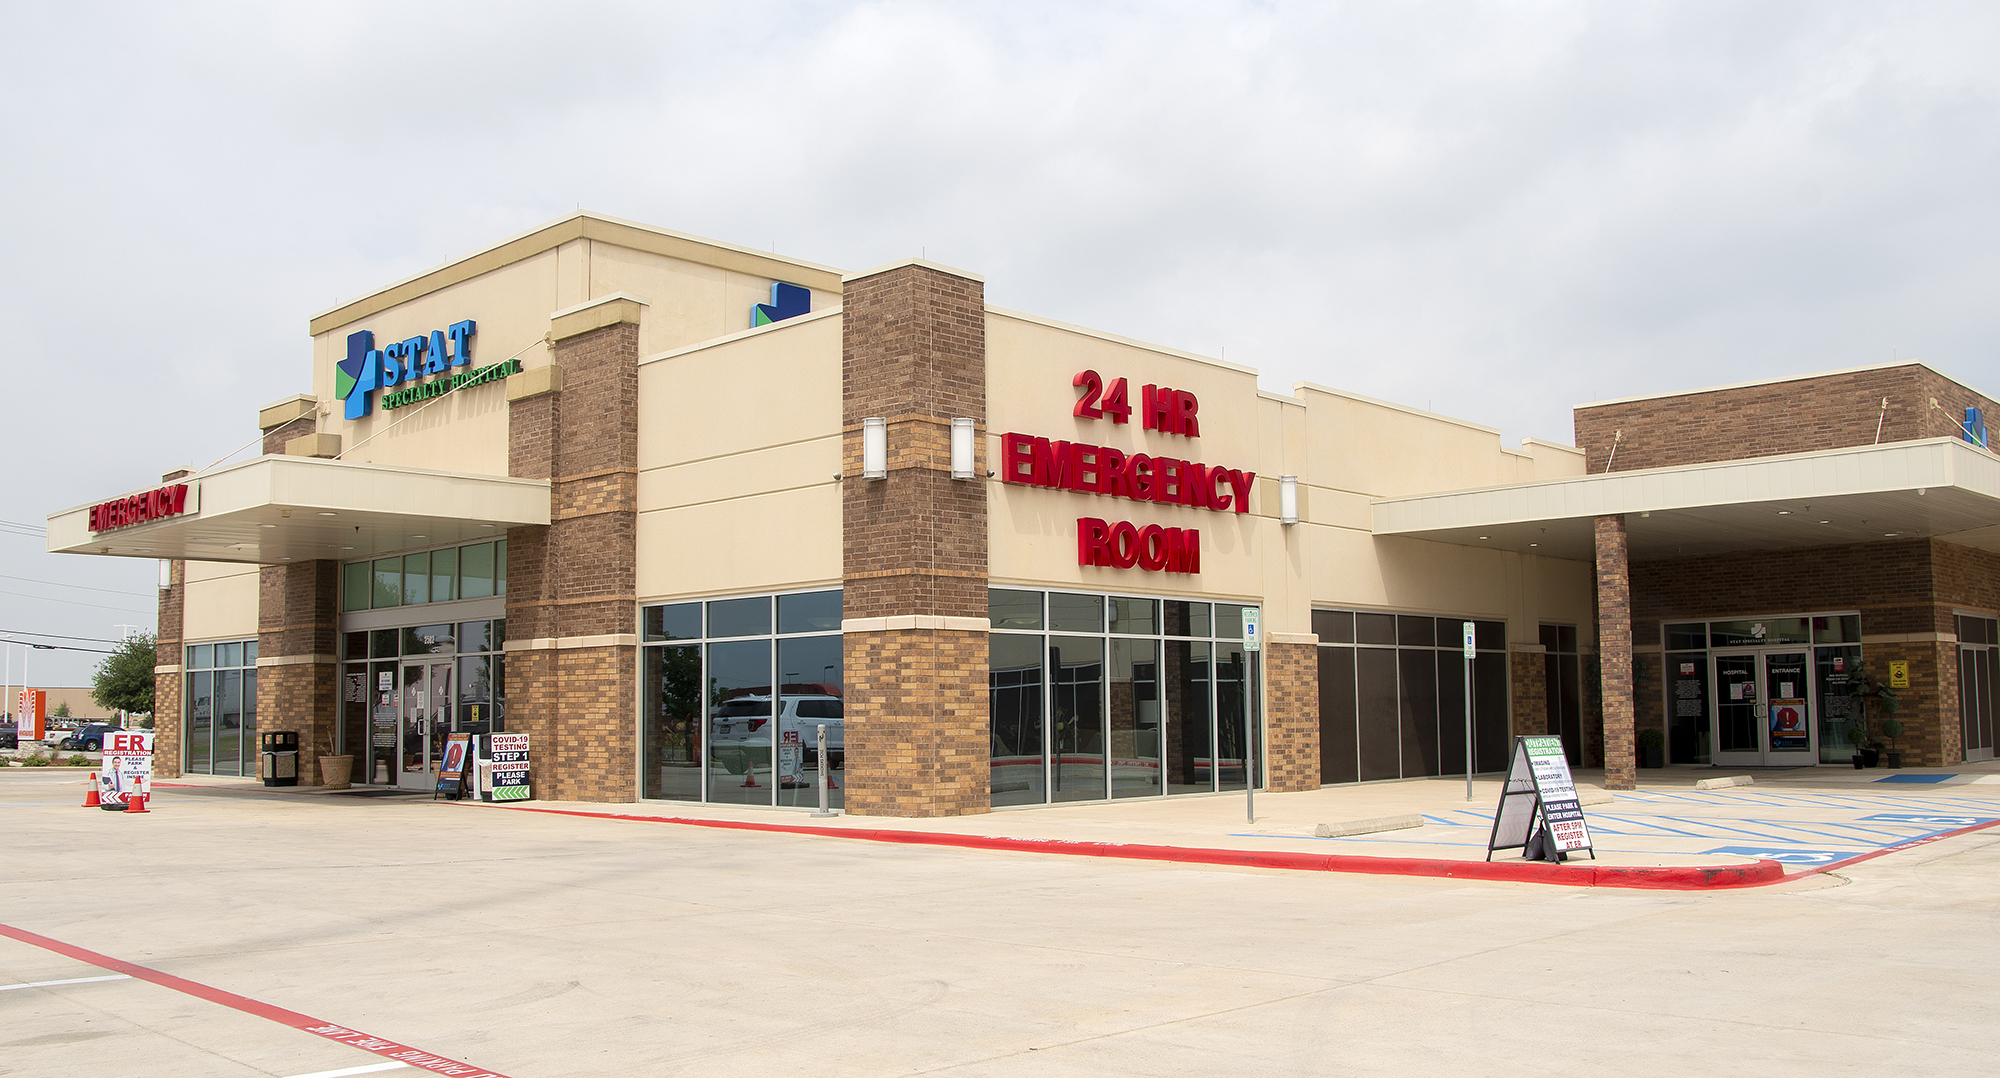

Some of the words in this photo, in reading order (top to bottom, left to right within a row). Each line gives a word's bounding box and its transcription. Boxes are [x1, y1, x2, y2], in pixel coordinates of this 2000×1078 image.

[383, 319, 476, 387] STAT
[382, 378, 449, 410] SPECIALTY
[451, 359, 523, 391] HOSPITAL
[1073, 369, 1132, 424] 24
[1142, 384, 1200, 438] HR
[1001, 432, 1256, 513] EMERGENCY
[88, 484, 187, 532] EMERGENCY
[1077, 517, 1200, 574] ROOM
[114, 735, 144, 750] ER
[494, 752, 520, 761] STEP
[522, 752, 527, 760] 1
[1528, 747, 1564, 755] REGISTRATION
[1553, 823, 1571, 832] AFTER
[1557, 831, 1584, 841] REGISTER
[1574, 840, 1582, 848] ER
[306, 1025, 362, 1040] LANE
[347, 1037, 399, 1051] FIRE
[389, 1050, 477, 1076] PARKING
